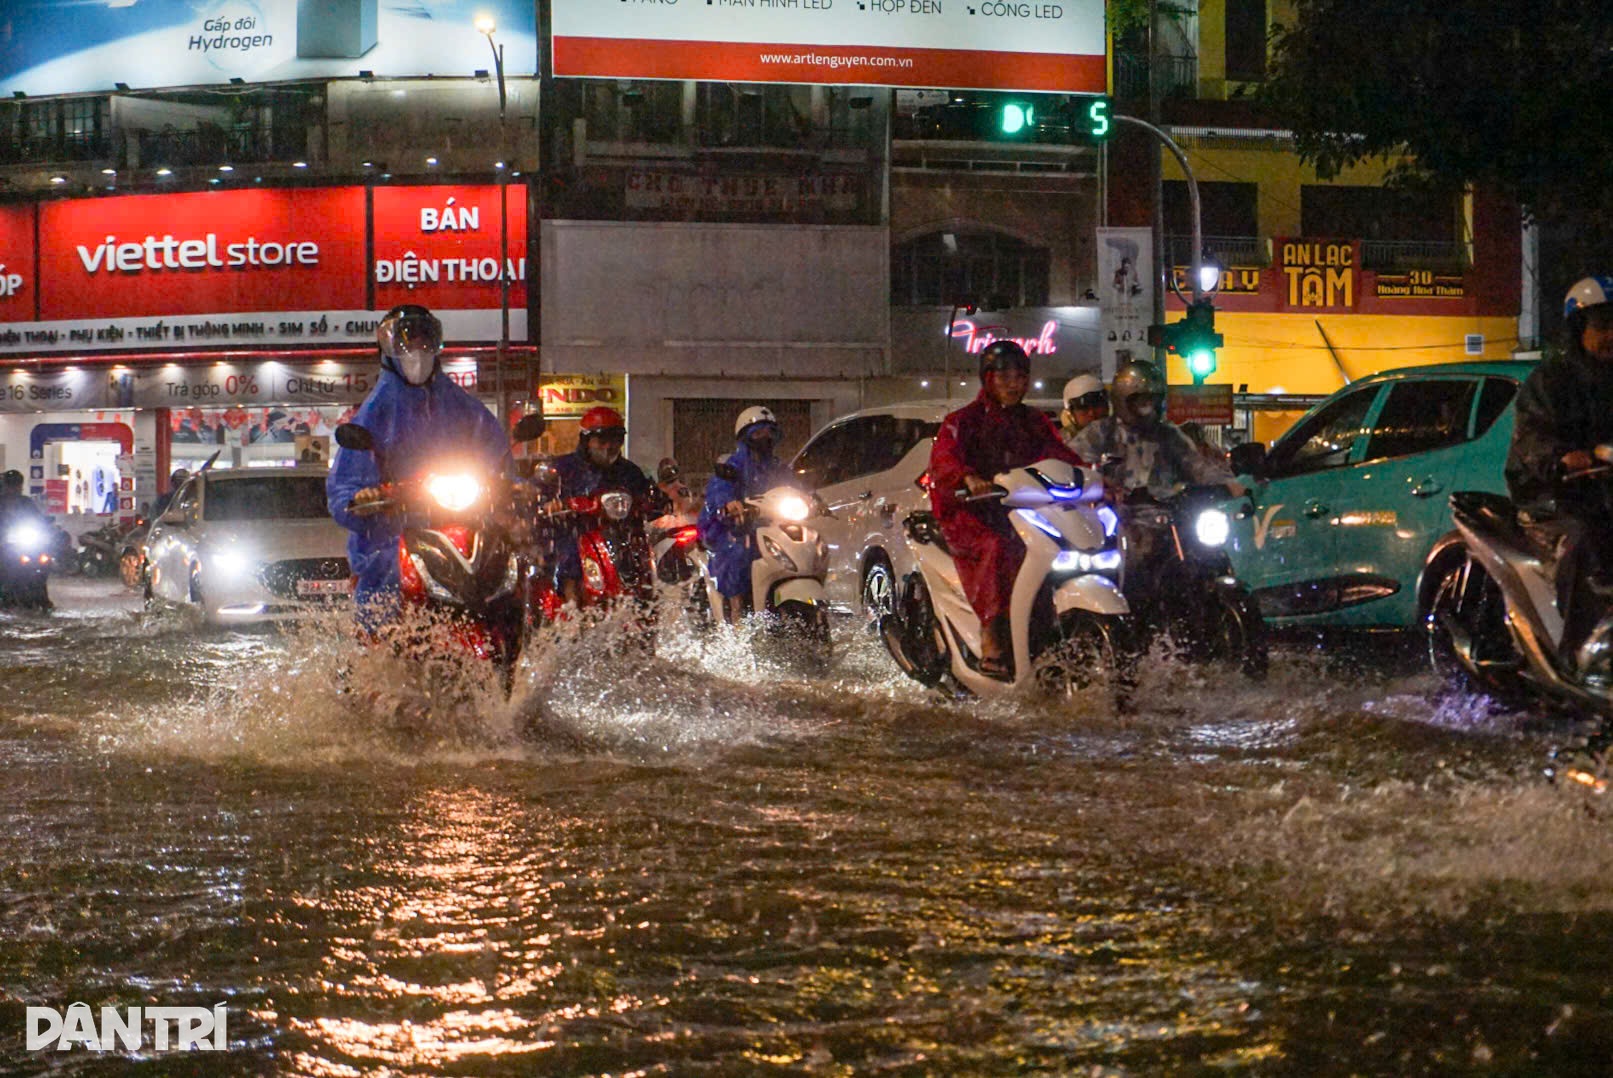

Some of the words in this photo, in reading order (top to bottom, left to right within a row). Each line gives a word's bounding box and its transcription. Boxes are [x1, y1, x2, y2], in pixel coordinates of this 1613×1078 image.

[1035, 5, 1063, 19] LED
[203, 16, 231, 33] Gấp
[234, 17, 256, 31] đôi
[188, 34, 273, 53] Hydrogen
[759, 53, 913, 68] www.artlenguyen.com.vn
[421, 197, 479, 231] BÁN
[77, 233, 223, 273] viettel
[227, 237, 319, 266] store
[375, 251, 439, 289] ĐIỆN
[1170, 270, 1260, 290] CAY
[1409, 271, 1432, 284] 30
[1284, 267, 1353, 307] TÂM
[97, 325, 124, 343] KIỆN
[136, 320, 169, 338] THIẾT
[189, 321, 229, 337] THÔNG
[232, 322, 264, 336] MINH
[279, 321, 303, 335] SIM
[29, 384, 73, 400] Series
[192, 381, 220, 400] góp
[225, 375, 259, 394] 0%
